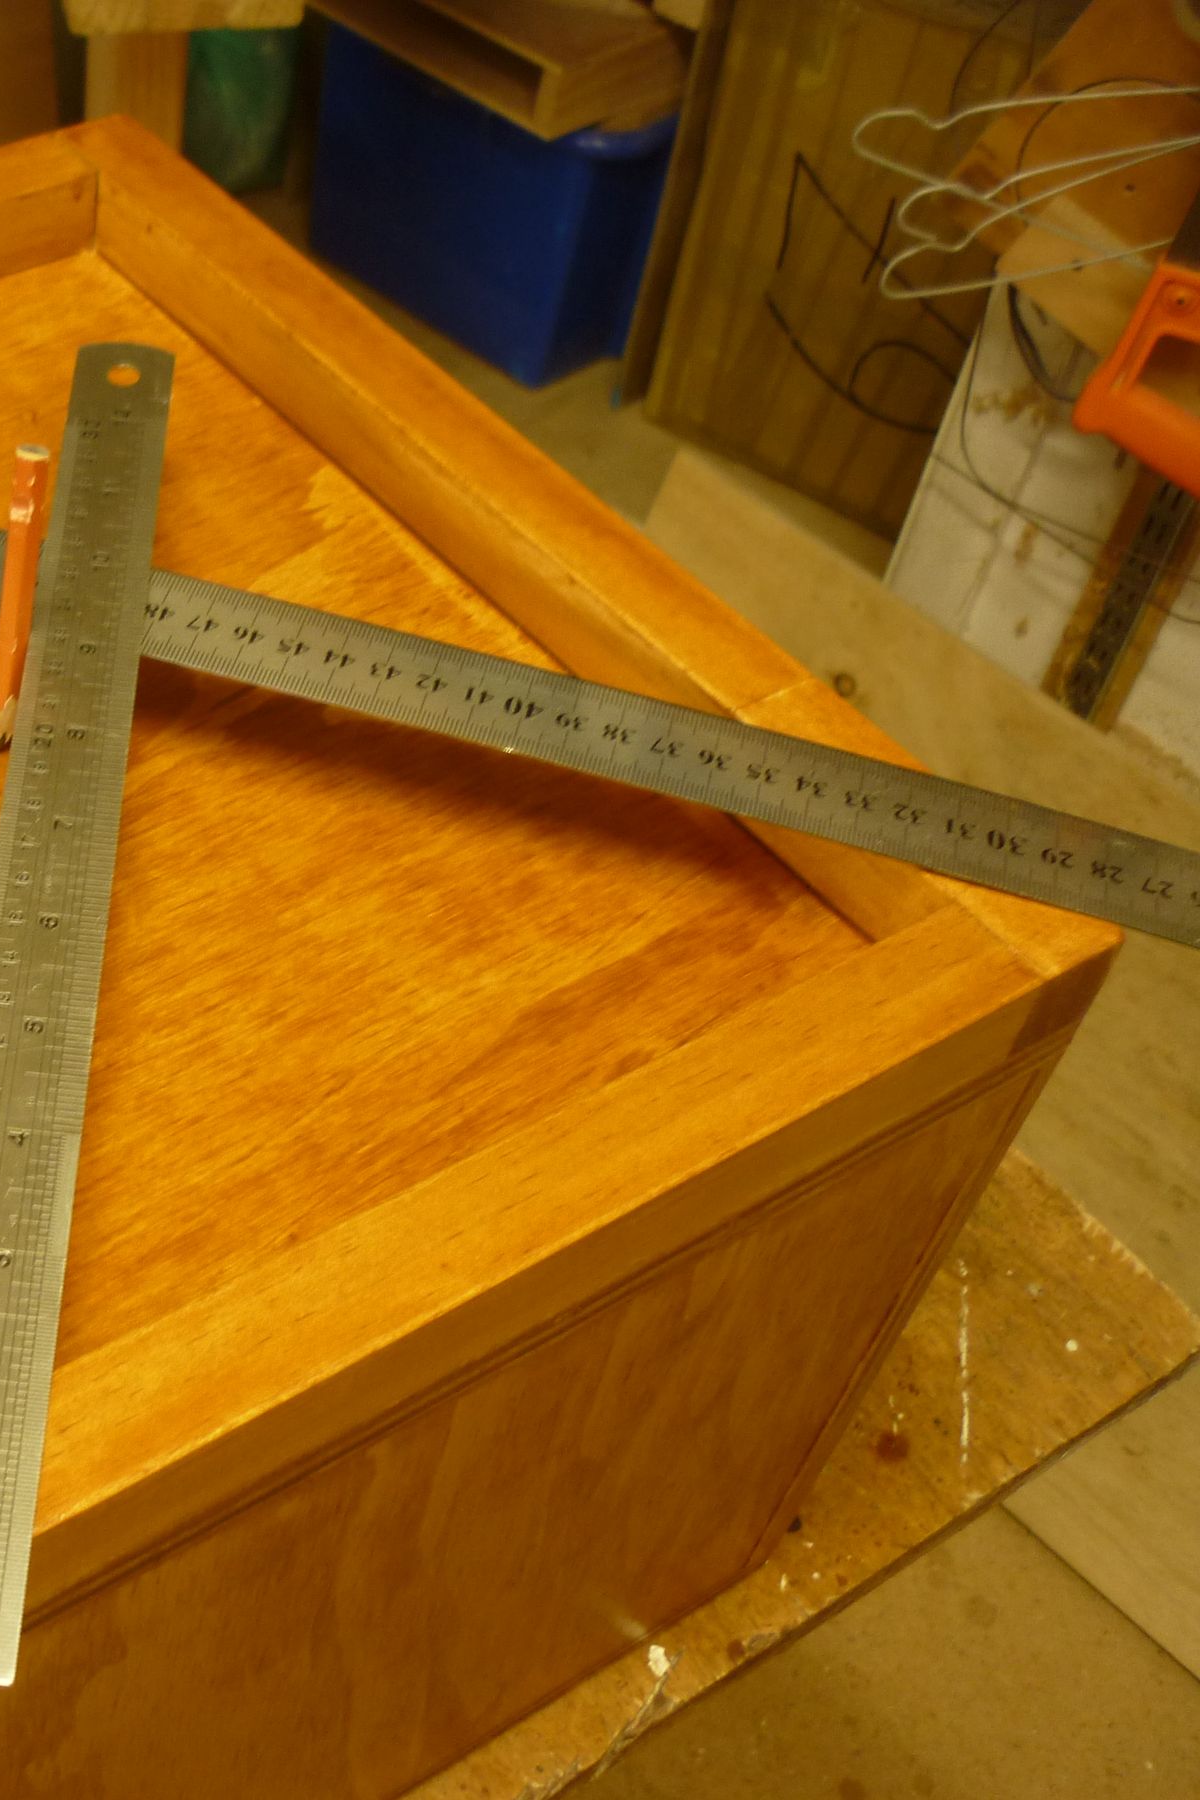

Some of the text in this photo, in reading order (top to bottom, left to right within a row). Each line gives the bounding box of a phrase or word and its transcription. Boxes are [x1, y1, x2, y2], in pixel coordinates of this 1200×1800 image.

[144, 603, 175, 623] 48
[186, 615, 219, 634] 47
[233, 626, 264, 645] 46
[276, 638, 310, 657] 45
[323, 649, 356, 669] 44
[370, 661, 402, 681] 43
[416, 673, 448, 694] 42
[465, 686, 494, 705] 41
[504, 696, 544, 724] 40
[556, 711, 589, 733] 39
[603, 724, 636, 746] 38
[649, 737, 684, 760] 37
[698, 748, 732, 772] 36
[746, 763, 780, 786] 35
[795, 775, 828, 799] 34
[844, 790, 877, 813] 33
[891, 802, 927, 826] 32
[946, 818, 976, 841] 31
[987, 829, 1026, 857] 30
[1040, 846, 1074, 870] 29
[1090, 860, 1123, 884] 28
[8, 1131, 29, 1146] 4
[23, 1019, 44, 1034] 5
[38, 915, 60, 930] 6
[53, 816, 72, 830] 7
[67, 729, 85, 739] 8
[79, 643, 96, 655] 9
[1141, 876, 1173, 900] 27
